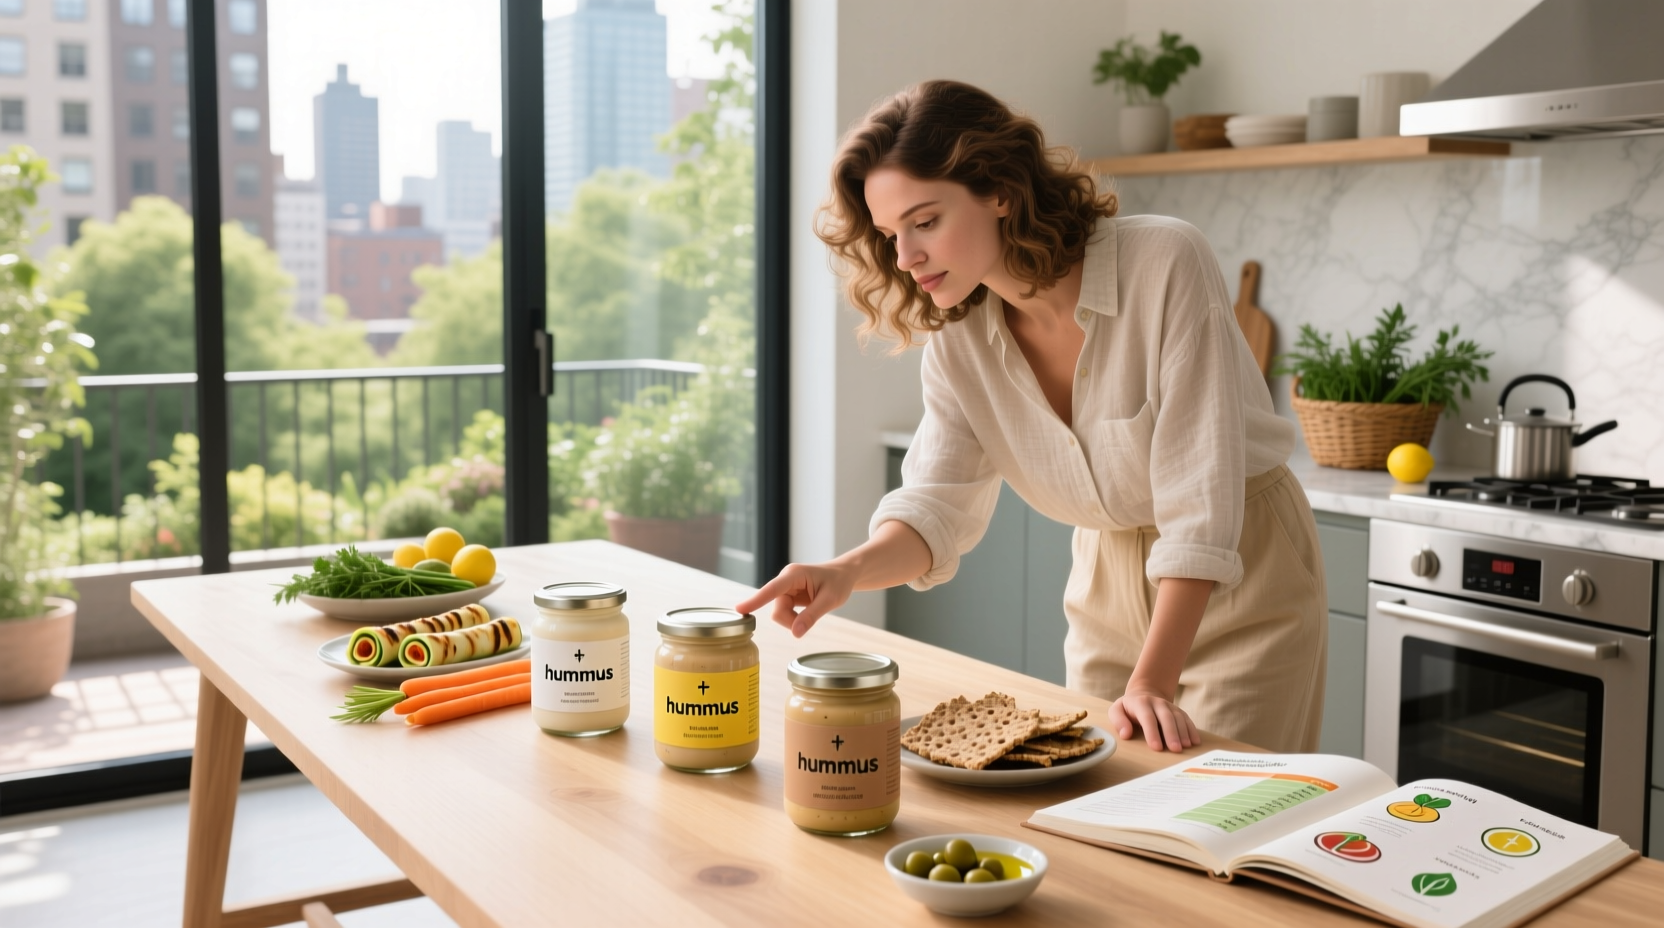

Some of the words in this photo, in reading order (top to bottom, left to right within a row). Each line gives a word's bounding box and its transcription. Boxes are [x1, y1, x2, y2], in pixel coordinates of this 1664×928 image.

[545, 664, 613, 682] hummus
[666, 696, 739, 716] hummus
[798, 751, 879, 774] hummus
